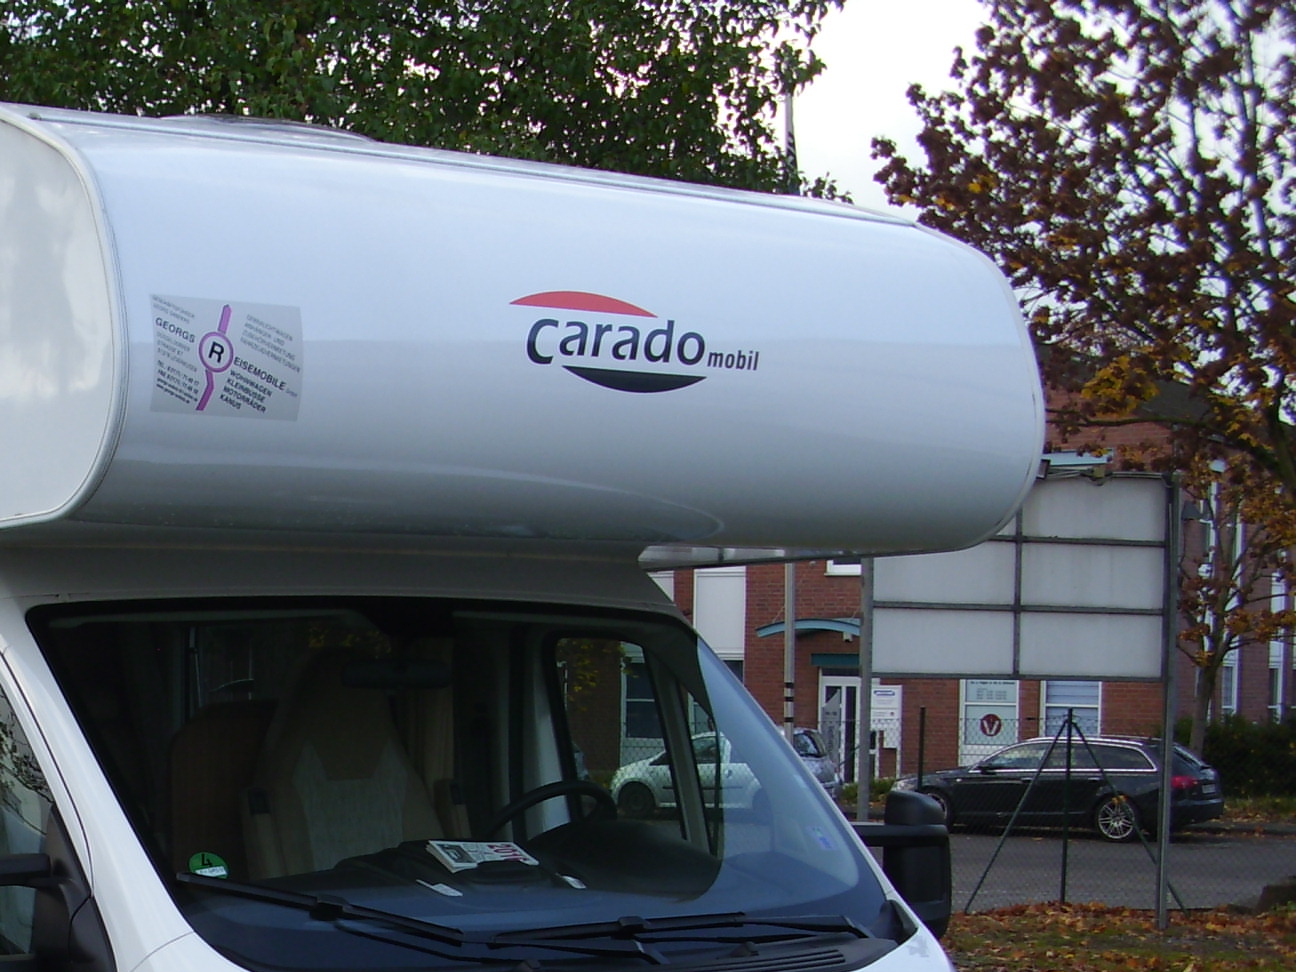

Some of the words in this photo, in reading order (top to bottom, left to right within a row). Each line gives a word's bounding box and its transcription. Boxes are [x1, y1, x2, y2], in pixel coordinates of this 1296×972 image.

[155, 317, 196, 343] GEORGS
[208, 341, 224, 363] R
[707, 350, 760, 371] mobil
